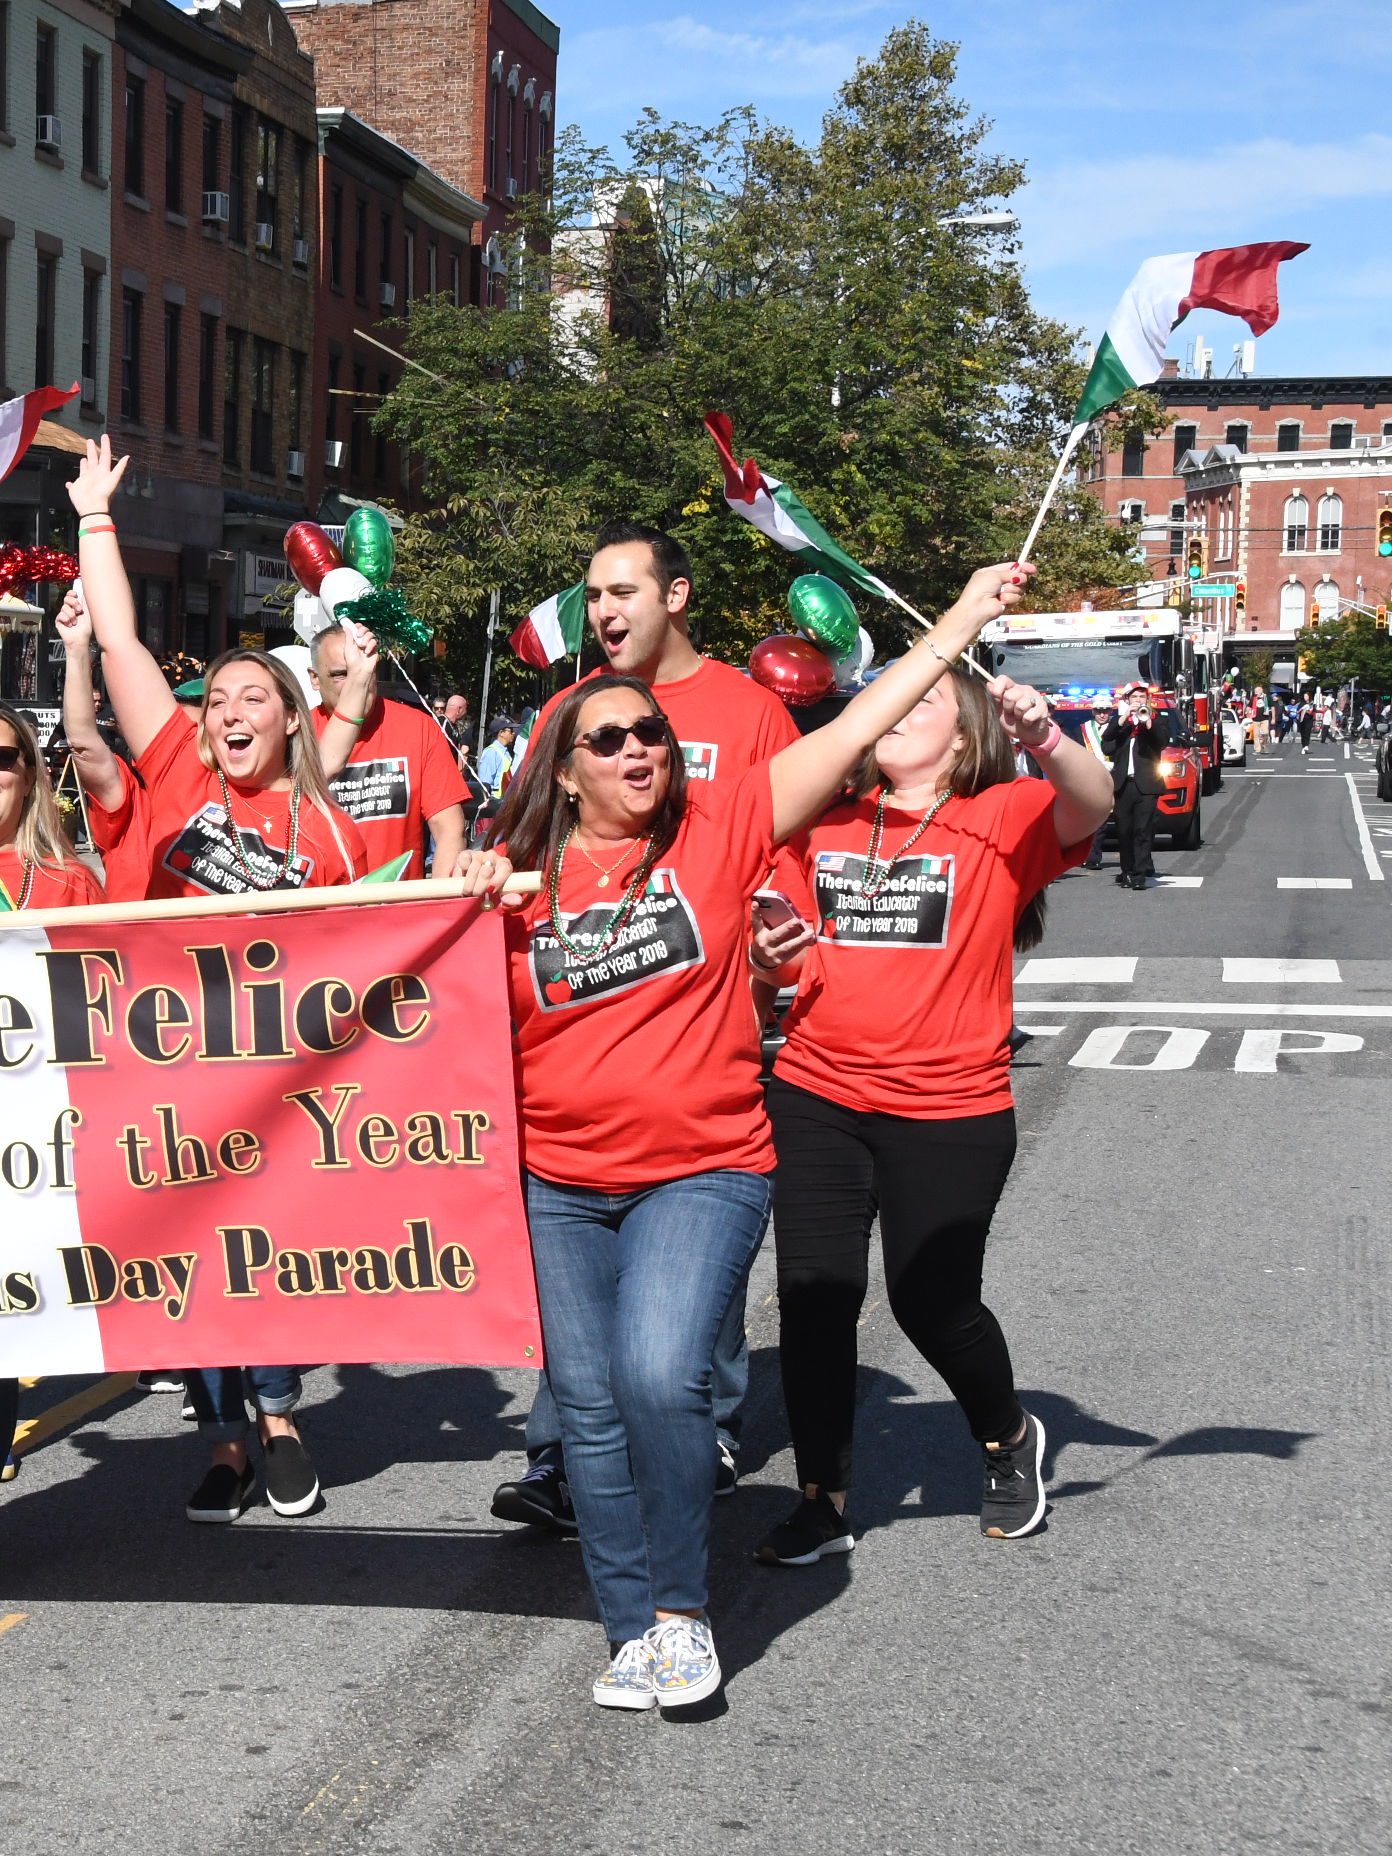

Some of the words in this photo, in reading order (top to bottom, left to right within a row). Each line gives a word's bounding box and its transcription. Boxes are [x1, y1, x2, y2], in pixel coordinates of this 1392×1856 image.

[328, 780, 363, 792] heresa
[195, 818, 240, 857] Theres
[246, 850, 303, 886] DeFelce
[817, 872, 866, 892] There
[836, 893, 871, 912] Italian
[872, 895, 921, 912] Educator
[894, 917, 919, 934] 2019
[535, 931, 614, 951] Thres
[641, 940, 669, 966] 2019
[1, 1106, 82, 1191] of
[116, 1104, 261, 1187] the
[284, 1083, 490, 1170] Year
[56, 1242, 199, 1321] Day
[214, 1217, 476, 1298] Parade
